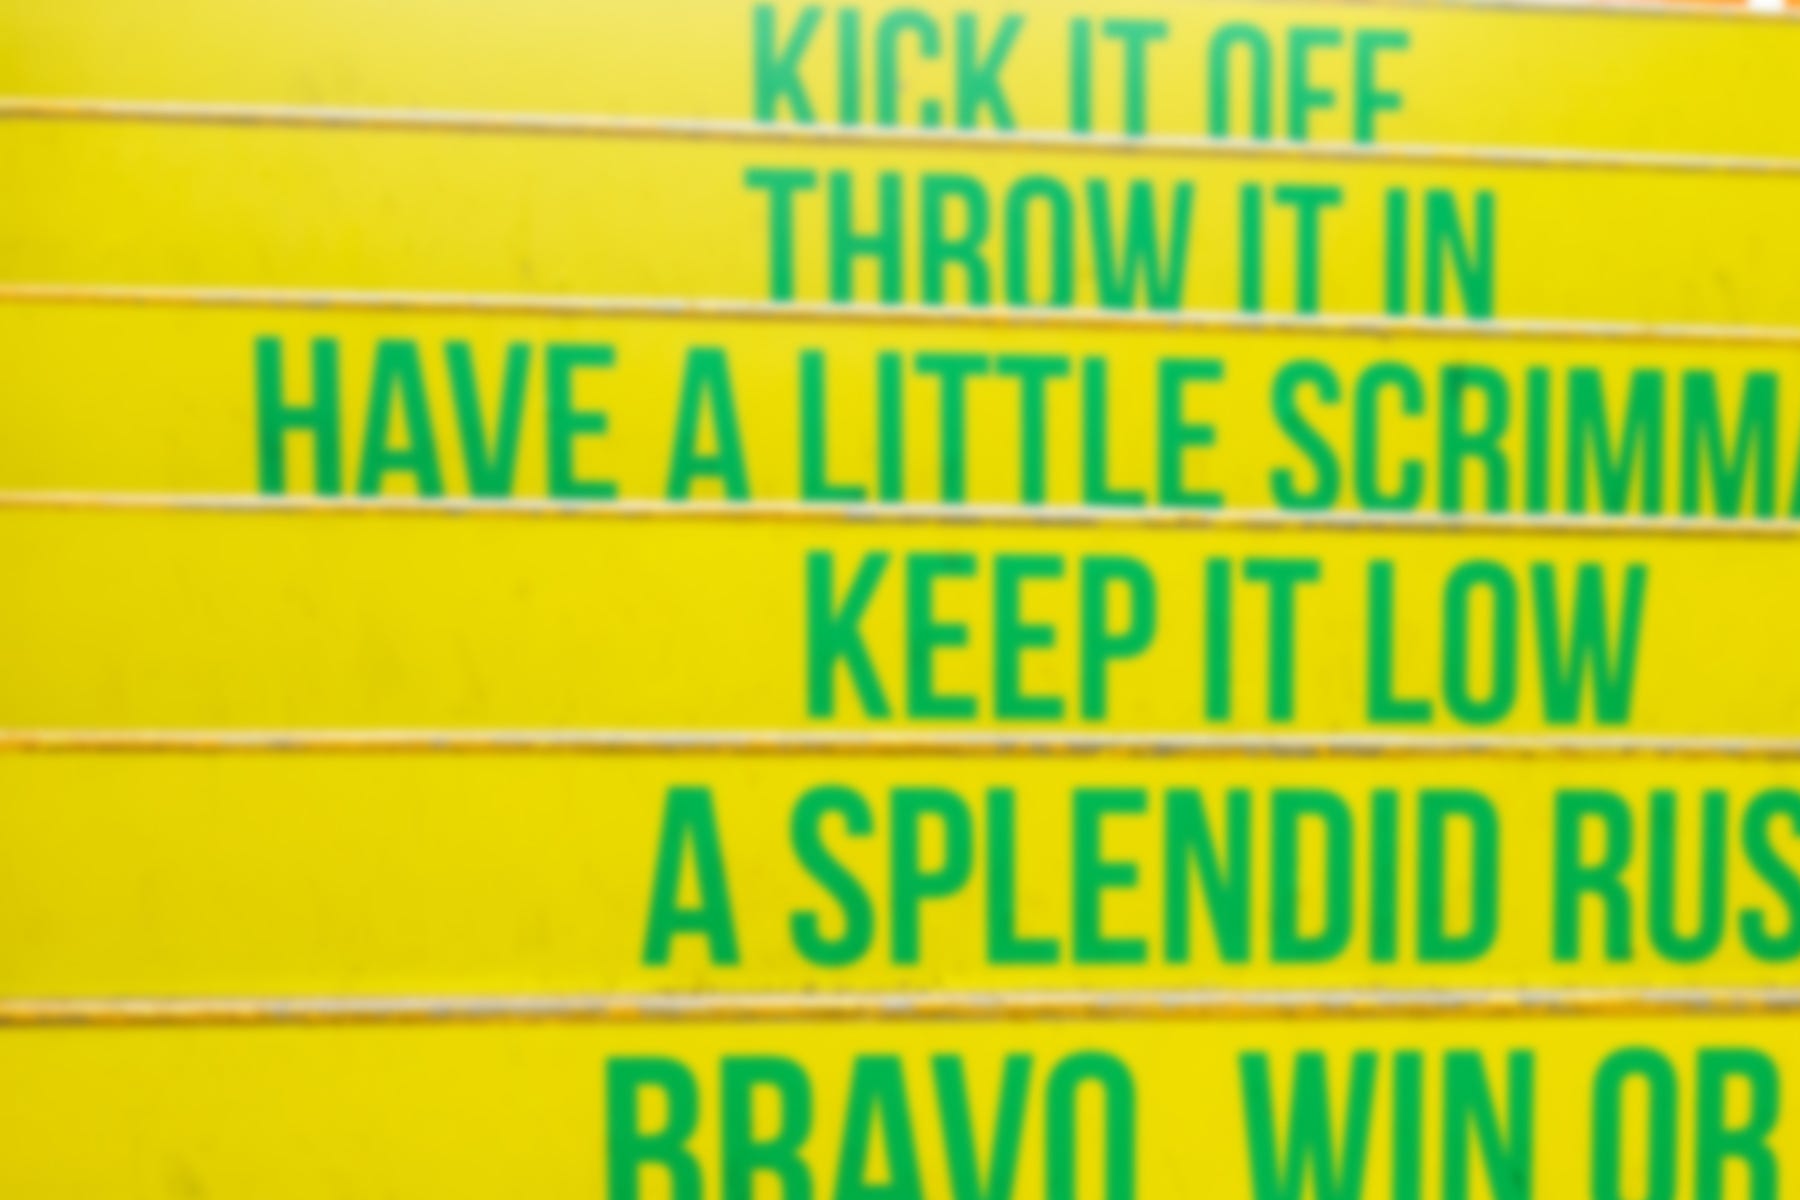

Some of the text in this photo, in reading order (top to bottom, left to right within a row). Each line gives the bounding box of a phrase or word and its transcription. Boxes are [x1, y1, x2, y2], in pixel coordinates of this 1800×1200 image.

[755, 5, 1411, 145] KICK IT OFF
[744, 166, 1496, 321] THROW IT IN
[254, 335, 618, 500] HAVE
[666, 346, 751, 501] A
[799, 348, 1225, 509] LITTLE
[806, 550, 1647, 726] KEEP IT LOW
[642, 786, 740, 966] A
[790, 784, 1500, 968] SPLENDID
